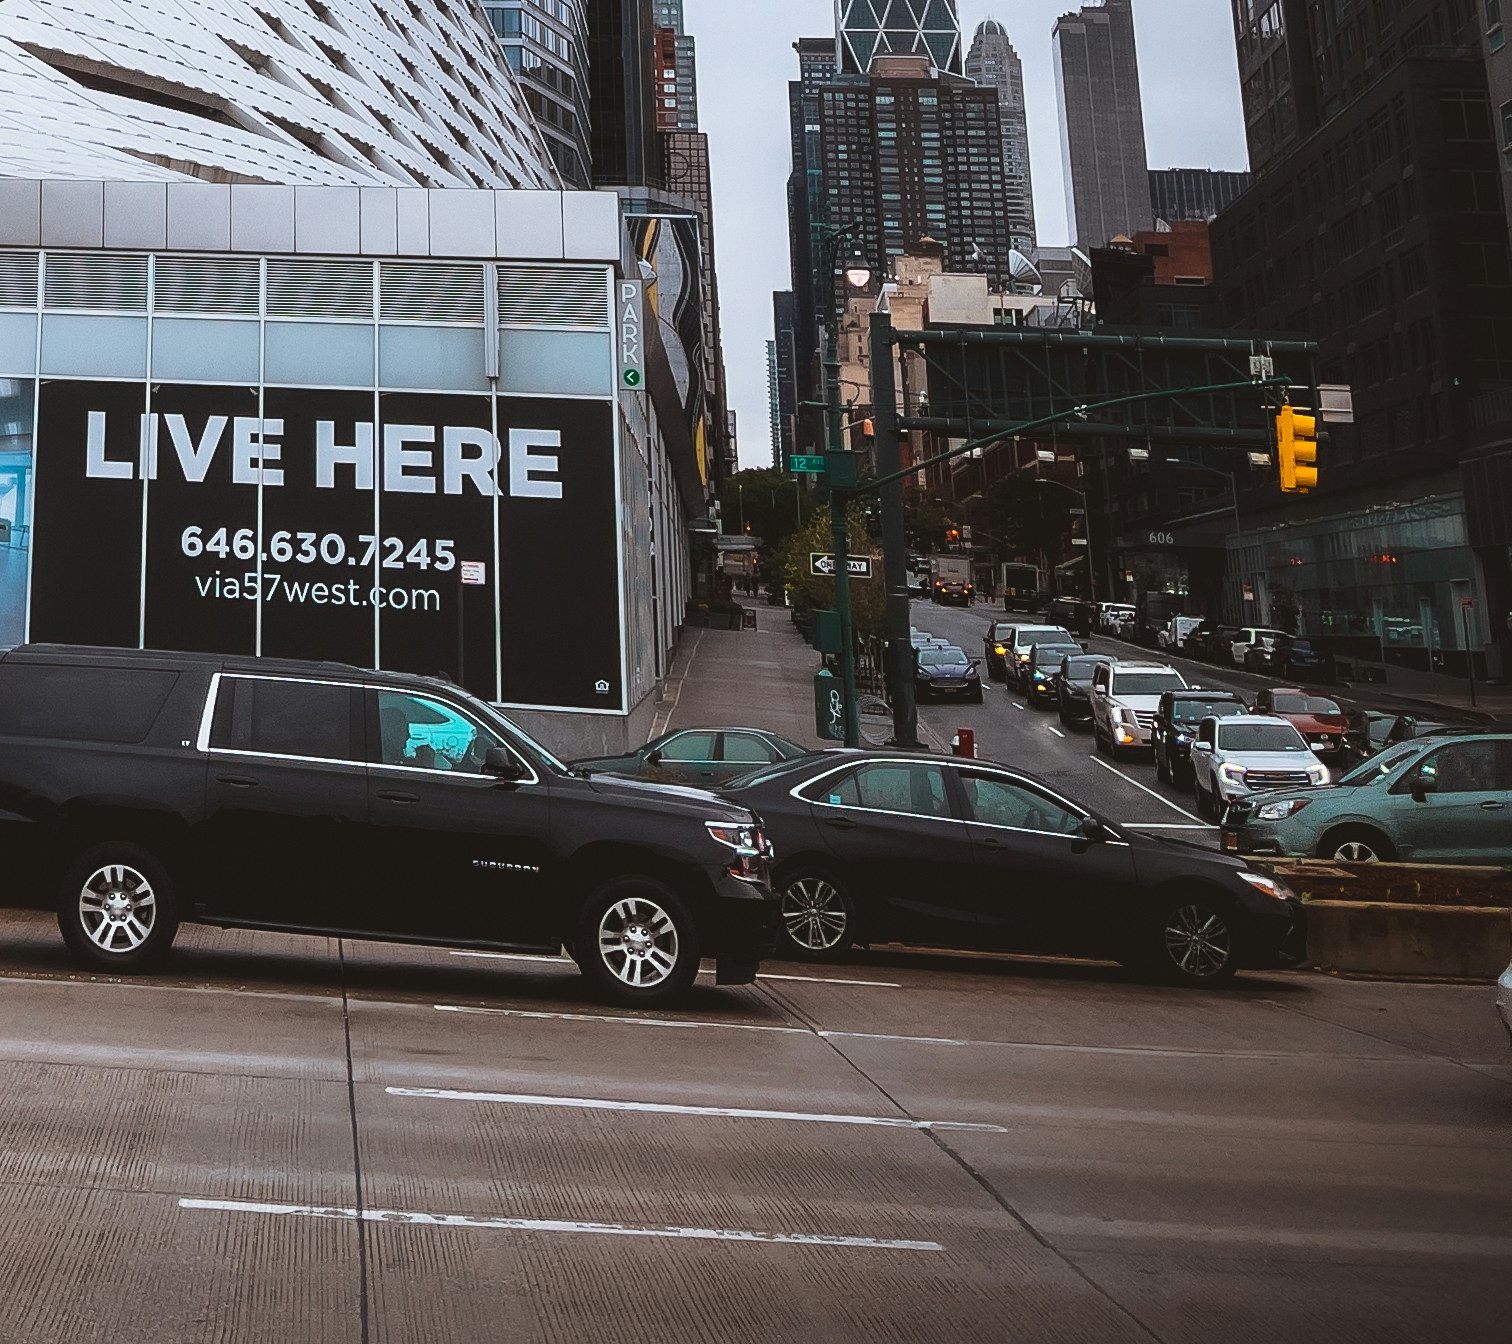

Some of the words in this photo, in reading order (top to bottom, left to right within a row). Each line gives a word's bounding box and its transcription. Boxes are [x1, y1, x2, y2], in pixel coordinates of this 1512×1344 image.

[621, 283, 640, 364] PARK
[86, 411, 284, 486] LIVE
[315, 420, 563, 499] HERE
[793, 458, 807, 469] 12
[181, 526, 456, 571] 646.630.7245
[1149, 531, 1174, 544] 606
[195, 570, 441, 611] via57west.com
